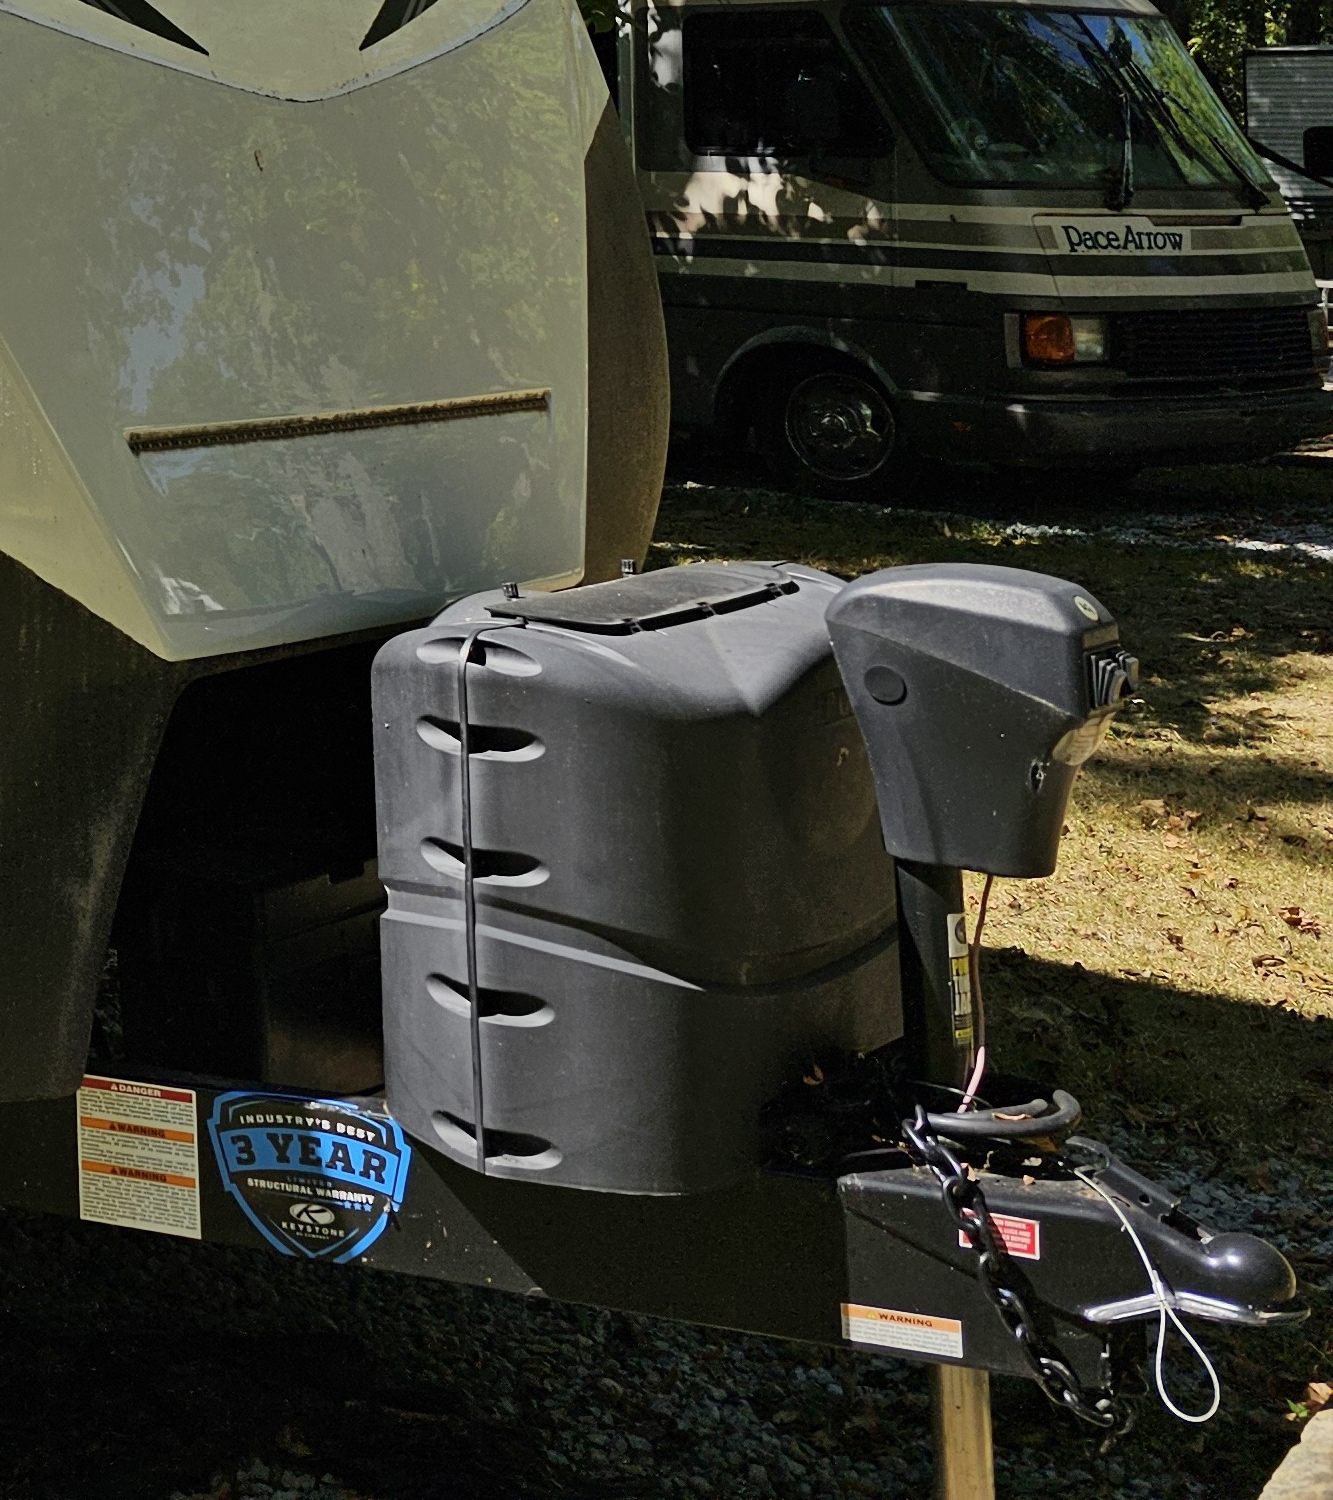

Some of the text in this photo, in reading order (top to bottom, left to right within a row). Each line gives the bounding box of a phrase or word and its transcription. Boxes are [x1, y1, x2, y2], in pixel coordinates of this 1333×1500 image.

[119, 1084, 162, 1098] DANGER
[118, 1123, 165, 1139] WARNING
[239, 1113, 376, 1142] INDUSTRY'S BEST
[230, 1134, 257, 1166] 3
[266, 1132, 387, 1184] YEAR
[119, 1167, 168, 1183] WARNING
[247, 1177, 375, 1205] STRUCTURAL WARRANTY
[281, 1220, 345, 1238] KEYSTONE
[878, 1312, 933, 1328] WARNING
